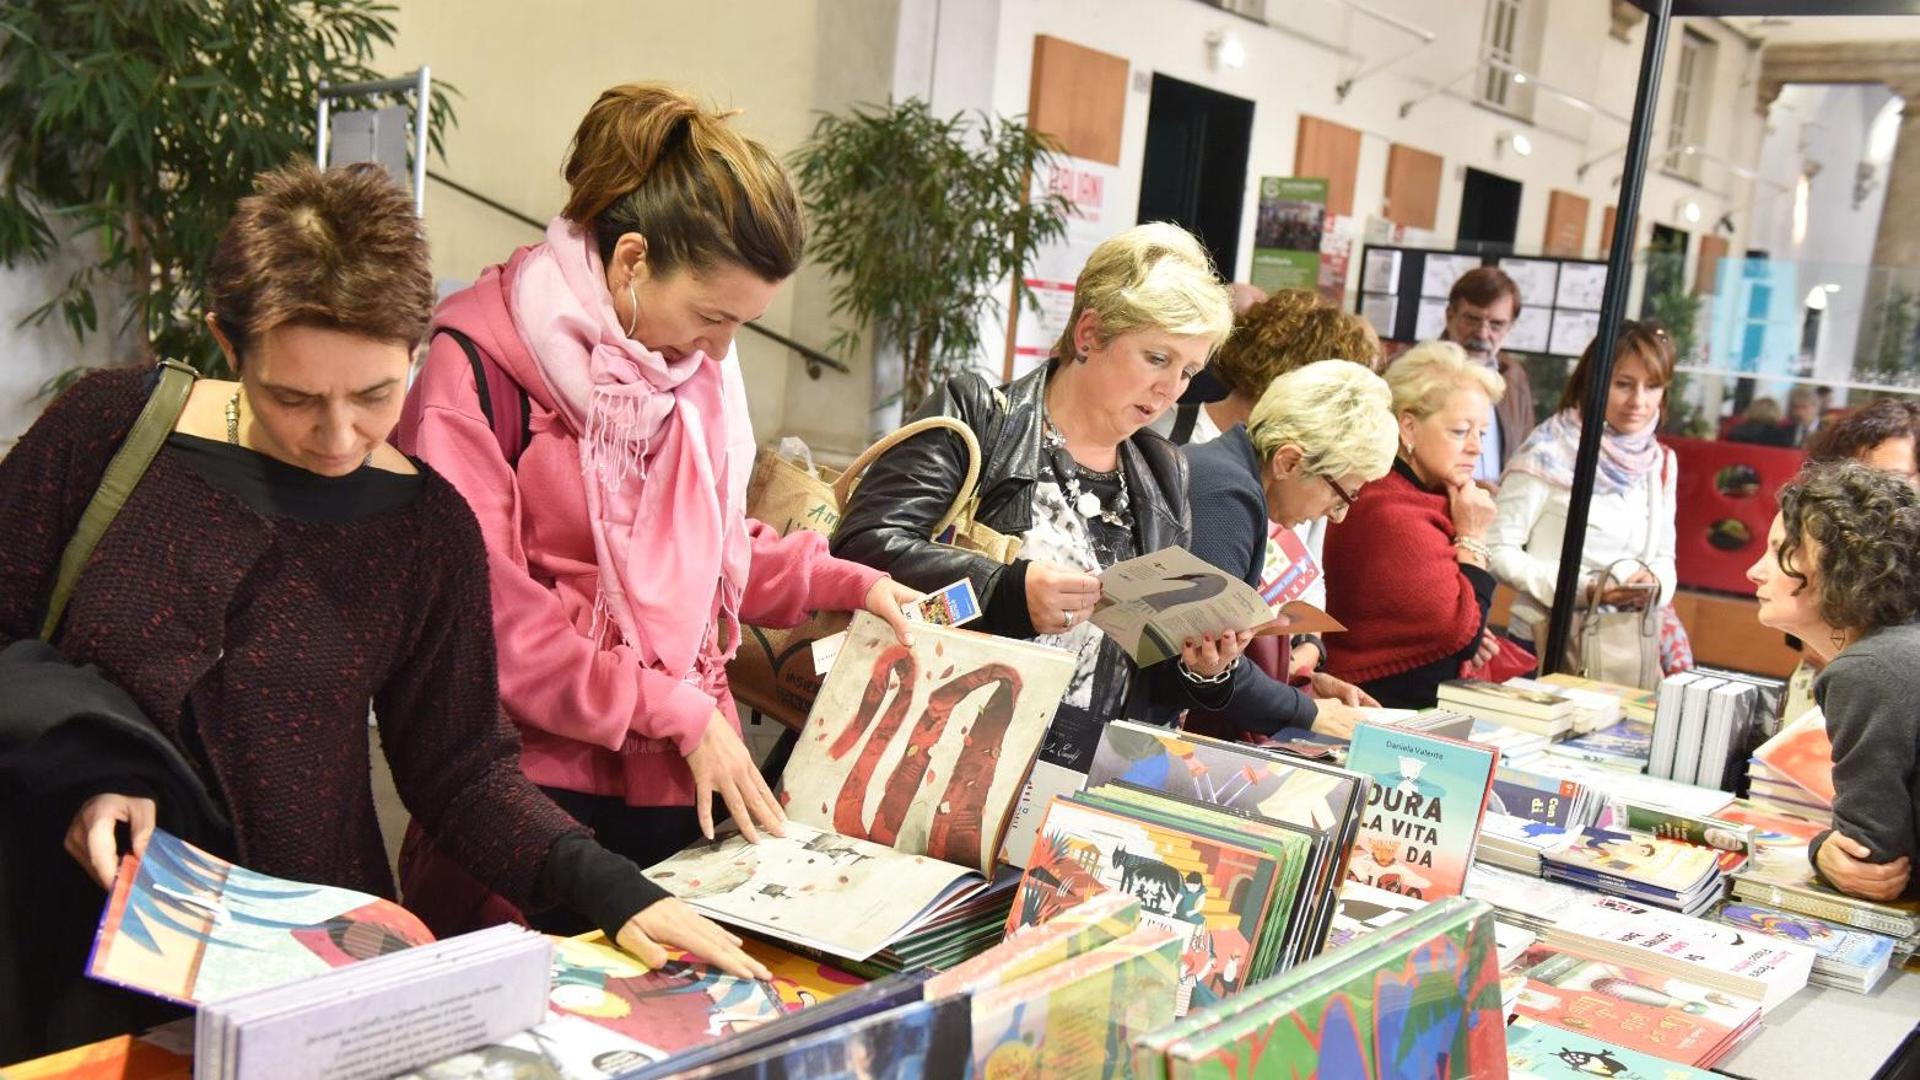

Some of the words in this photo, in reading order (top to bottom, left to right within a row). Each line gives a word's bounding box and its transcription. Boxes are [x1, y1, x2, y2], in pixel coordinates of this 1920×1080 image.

[1386, 740, 1414, 753] Daniela
[1415, 747, 1444, 760] Valente
[1391, 818, 1438, 846] VITA
[1405, 846, 1432, 868] DA
